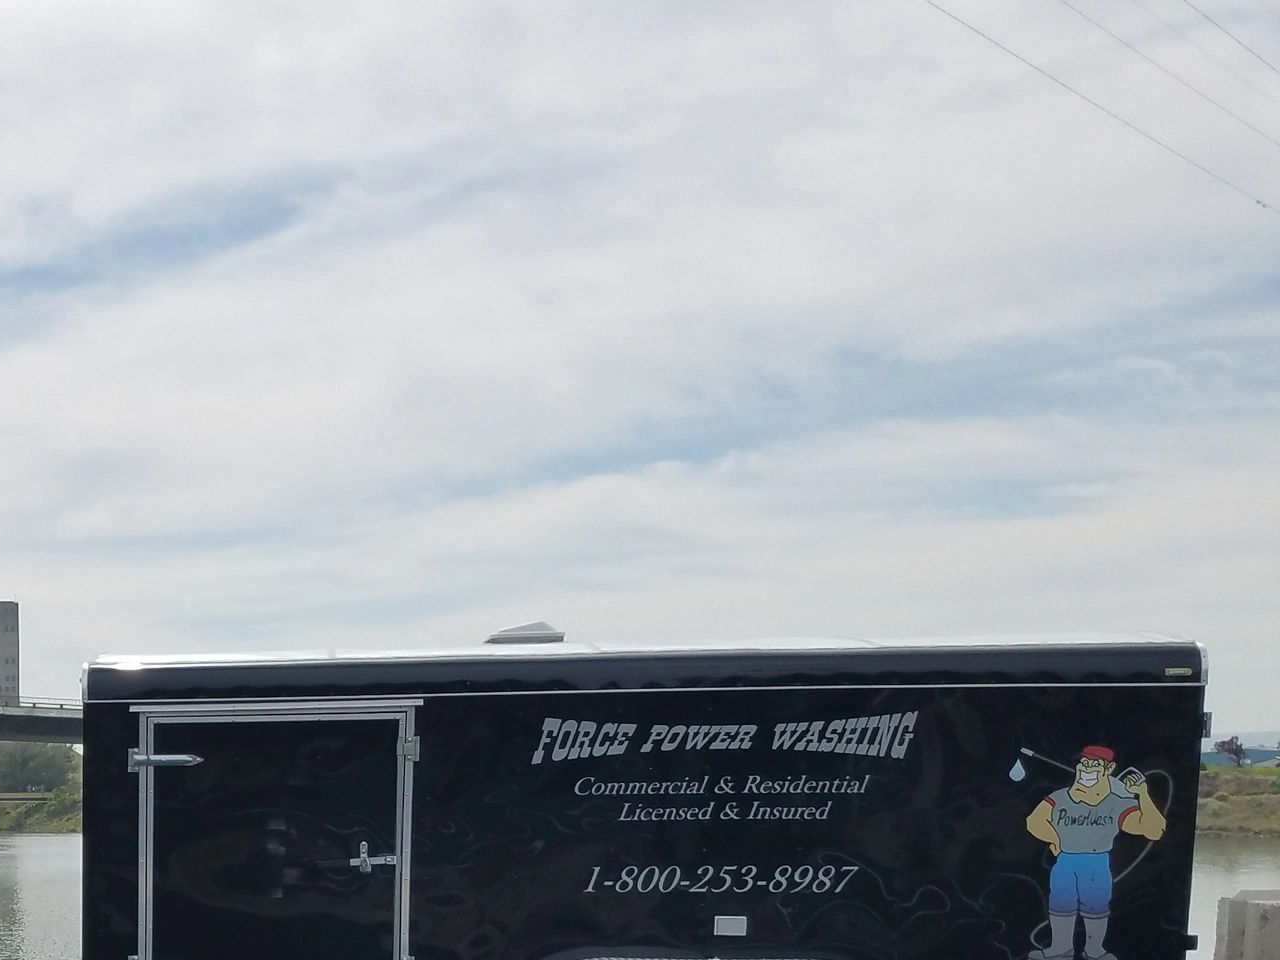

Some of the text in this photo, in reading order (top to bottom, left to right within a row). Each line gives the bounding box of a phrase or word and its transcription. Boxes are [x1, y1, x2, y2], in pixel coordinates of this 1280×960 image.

[530, 710, 919, 765] FORCE POWER WASHING
[573, 774, 871, 797] Commercial & Residential
[618, 801, 832, 822] Licensed & Insured
[582, 864, 860, 894] 1-800-253-8987
